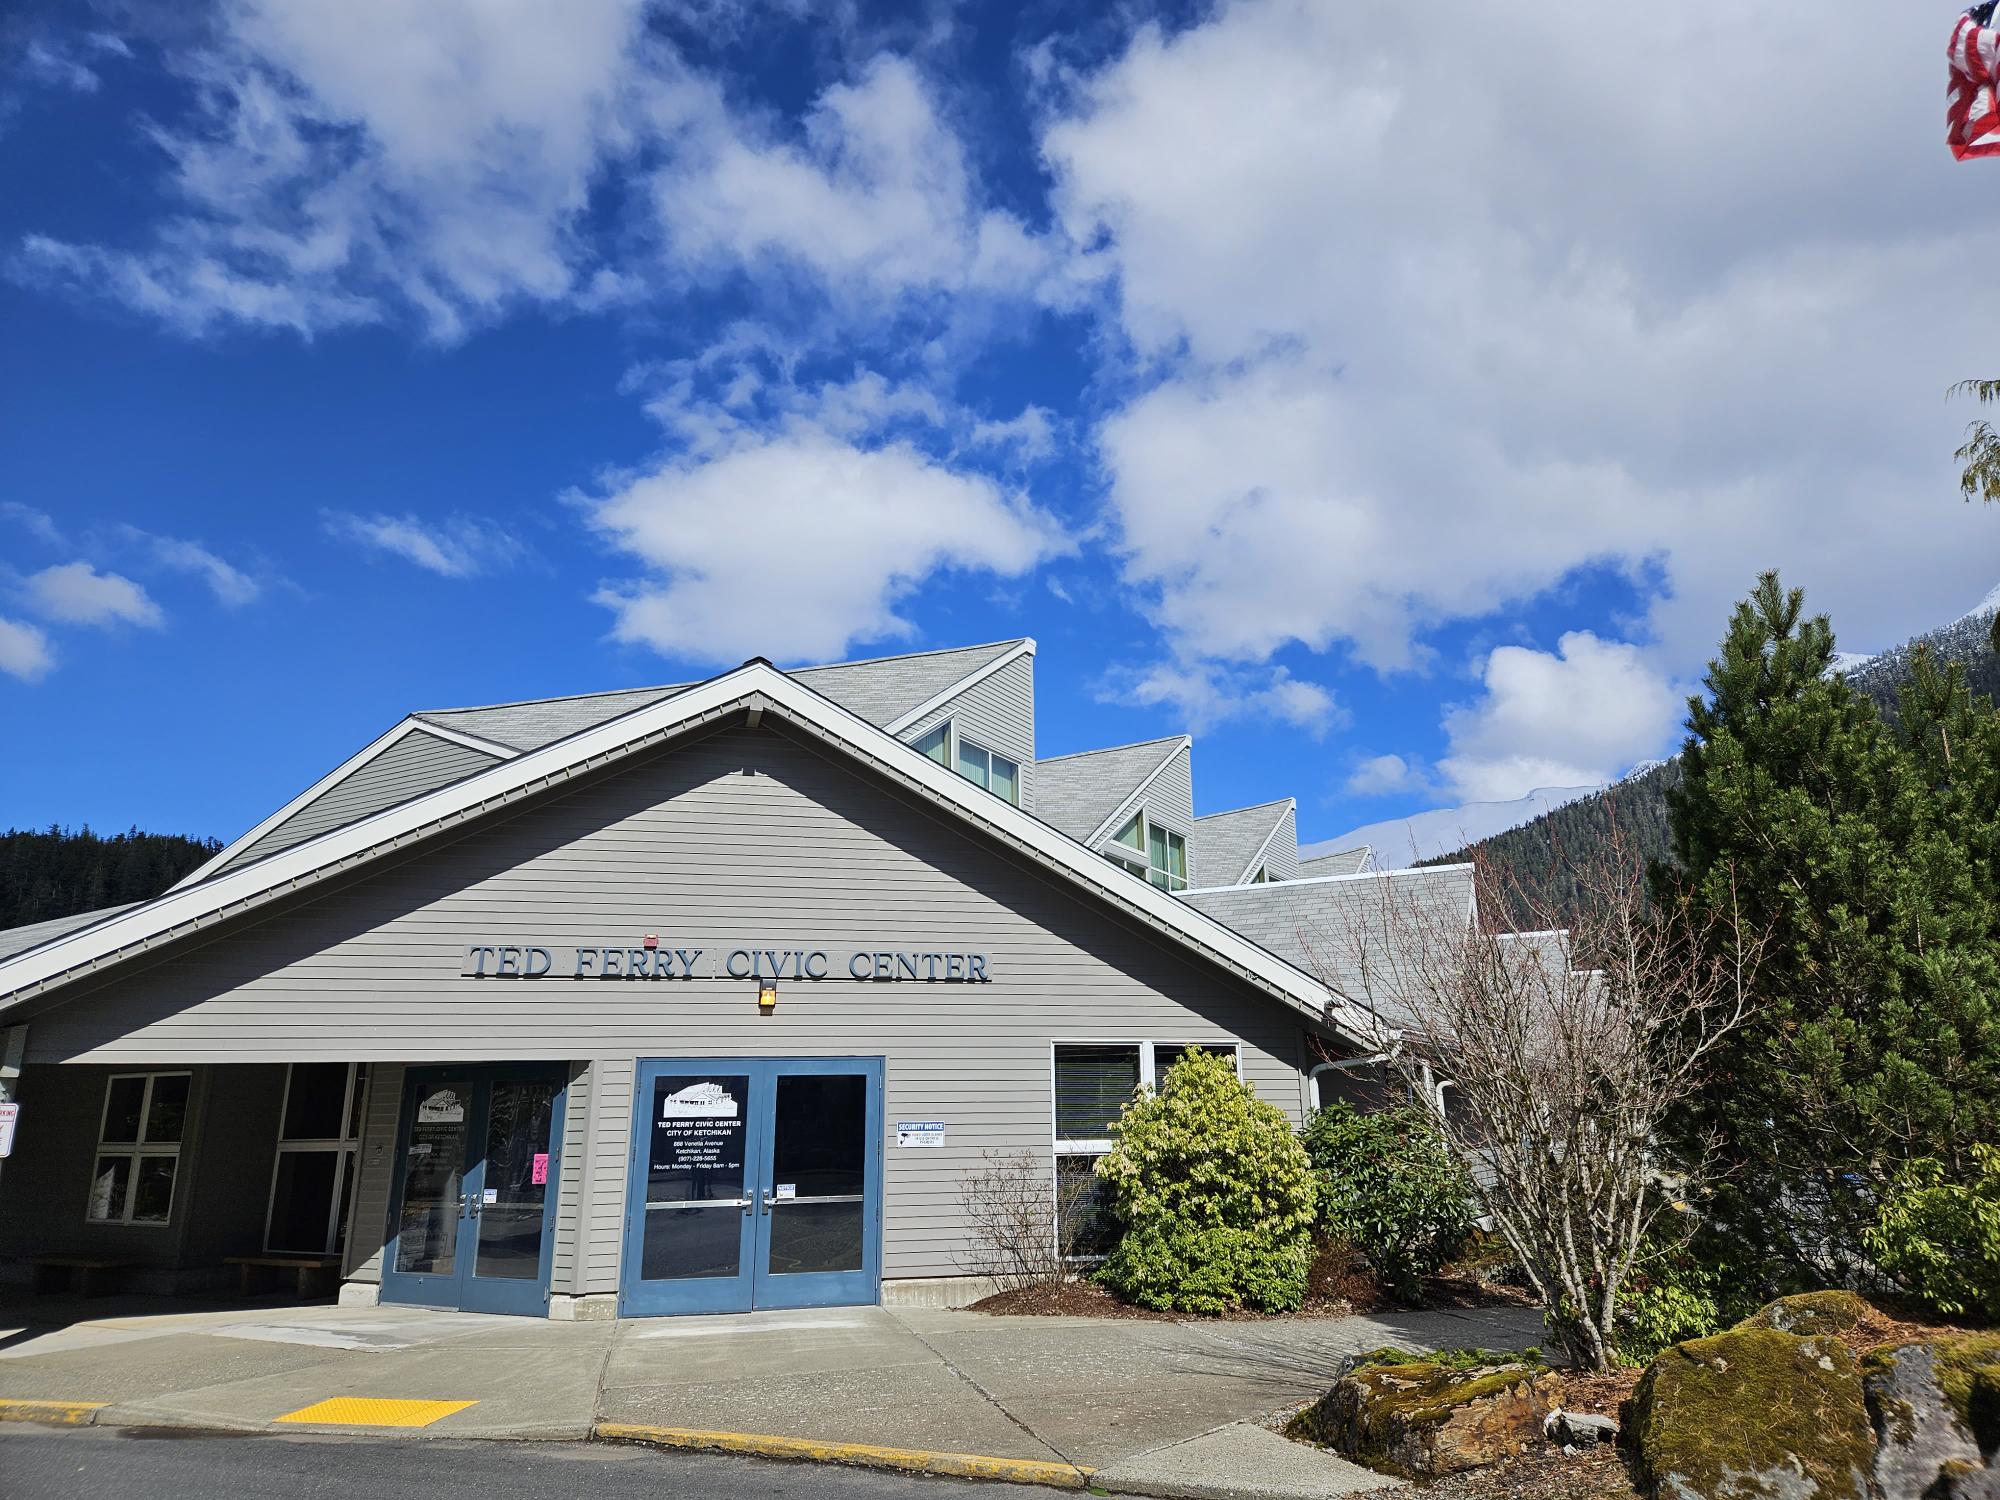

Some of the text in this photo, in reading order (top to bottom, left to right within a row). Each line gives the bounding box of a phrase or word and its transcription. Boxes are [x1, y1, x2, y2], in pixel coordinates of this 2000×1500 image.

[470, 947, 989, 980] TED FERRY CIVIC CENTER
